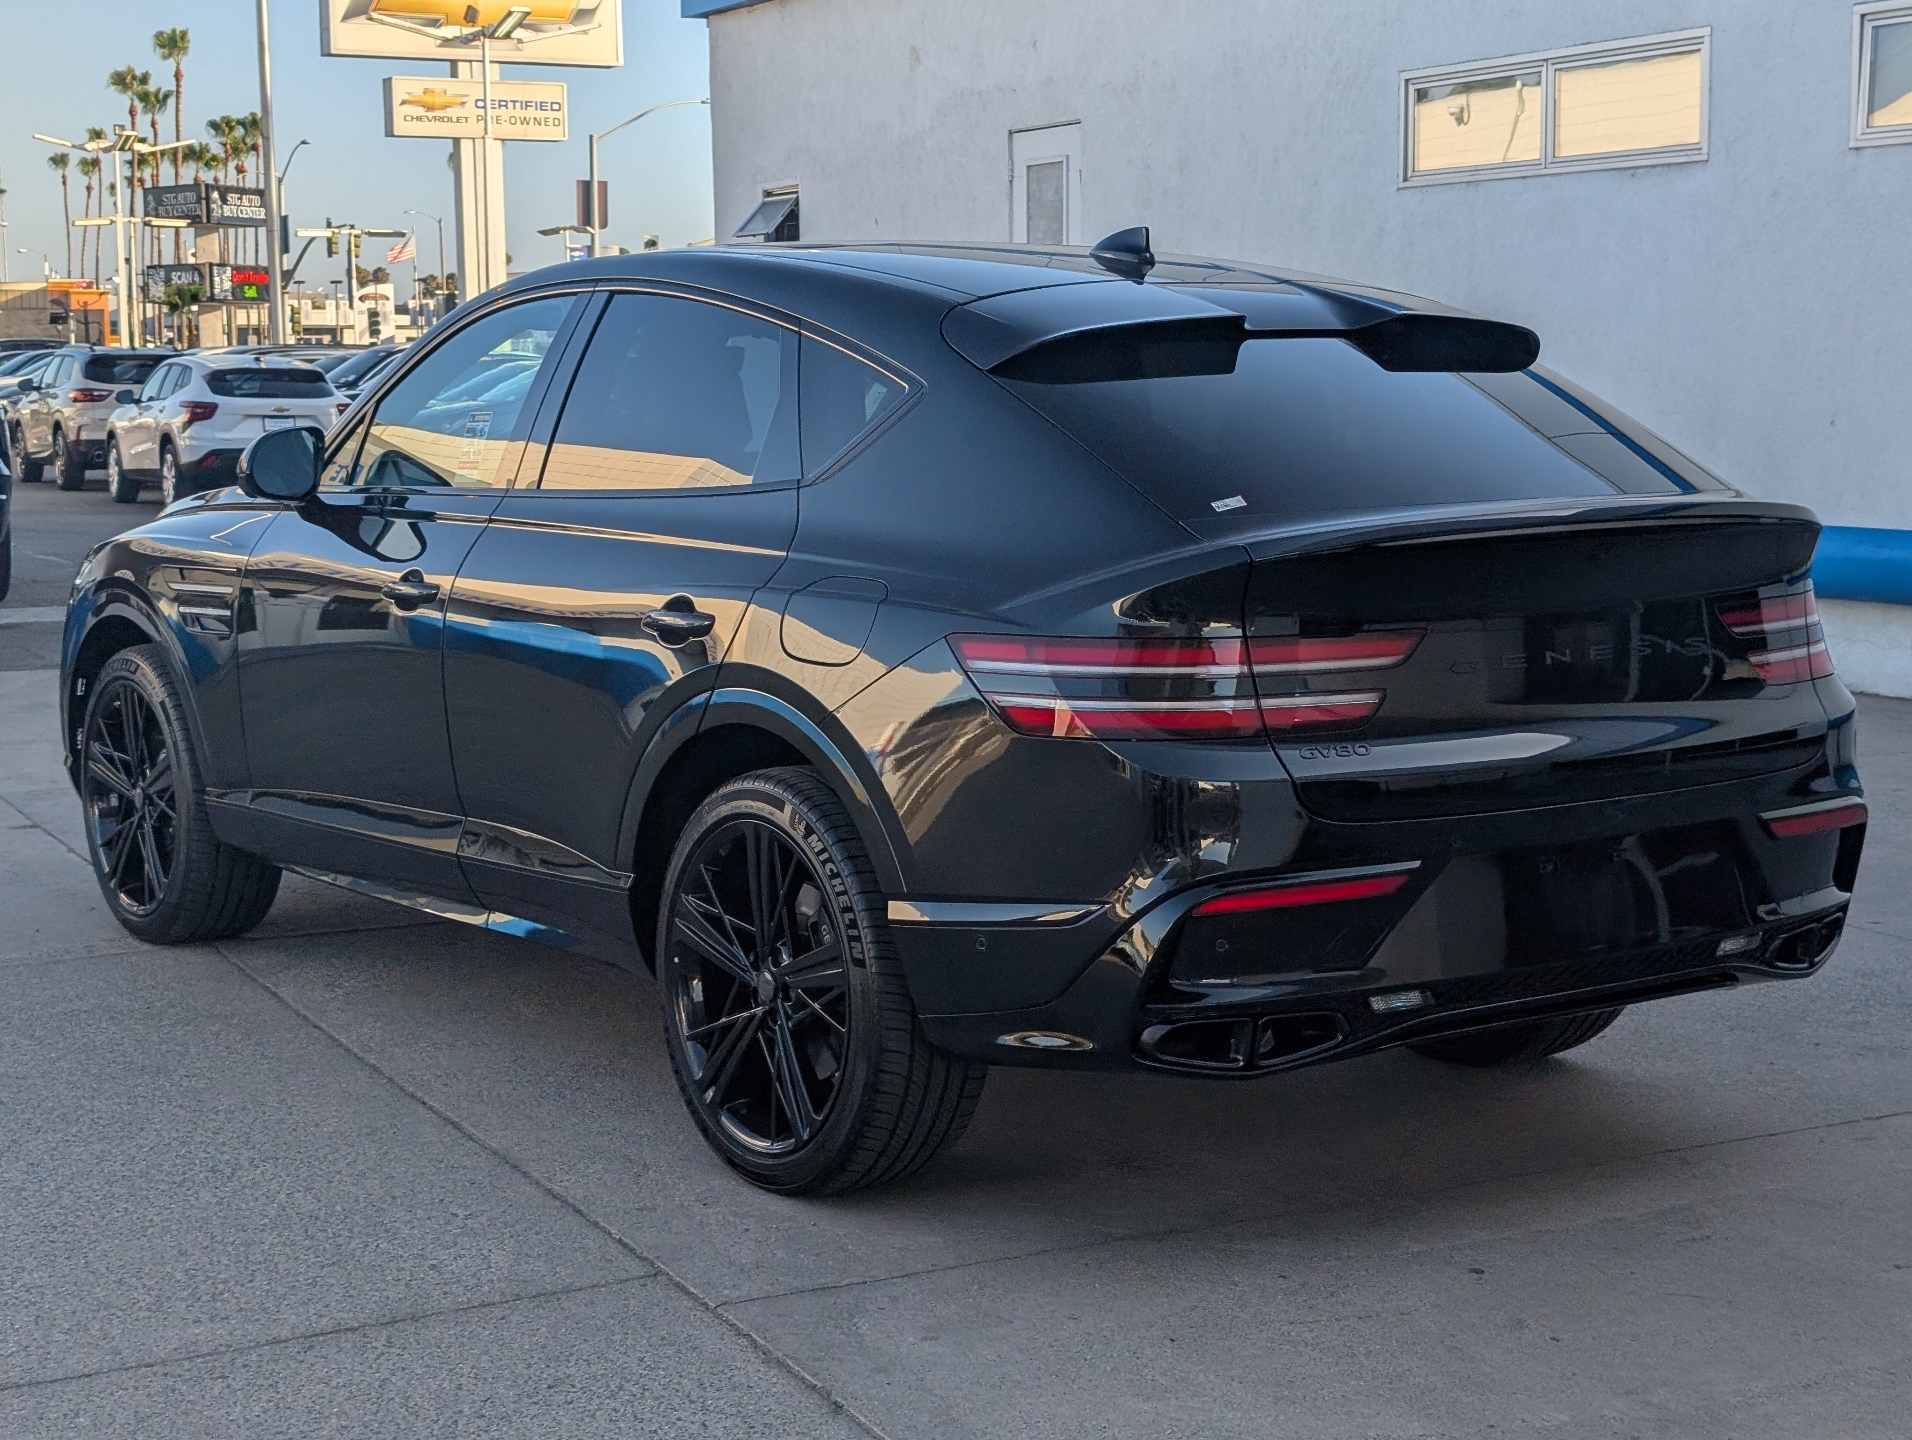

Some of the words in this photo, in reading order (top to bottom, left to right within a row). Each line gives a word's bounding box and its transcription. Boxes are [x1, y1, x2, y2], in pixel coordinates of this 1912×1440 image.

[474, 98, 562, 112] CERTIFIED
[403, 114, 471, 124] CHEVROLET
[162, 193, 176, 205] STG
[176, 192, 196, 205] AUTO
[226, 193, 241, 206] STG
[241, 194, 261, 207] AUTO
[158, 205, 173, 217] BUY
[173, 203, 202, 217] CENTER
[223, 204, 237, 217] BUY
[237, 205, 267, 219] CENTER
[170, 271, 192, 284] SCAN
[232, 270, 248, 282] Don't
[243, 285, 258, 298] Sell
[1450, 636, 1712, 675] GENESIS
[1298, 743, 1373, 760] GV80
[806, 833, 866, 961] MICHELIN
